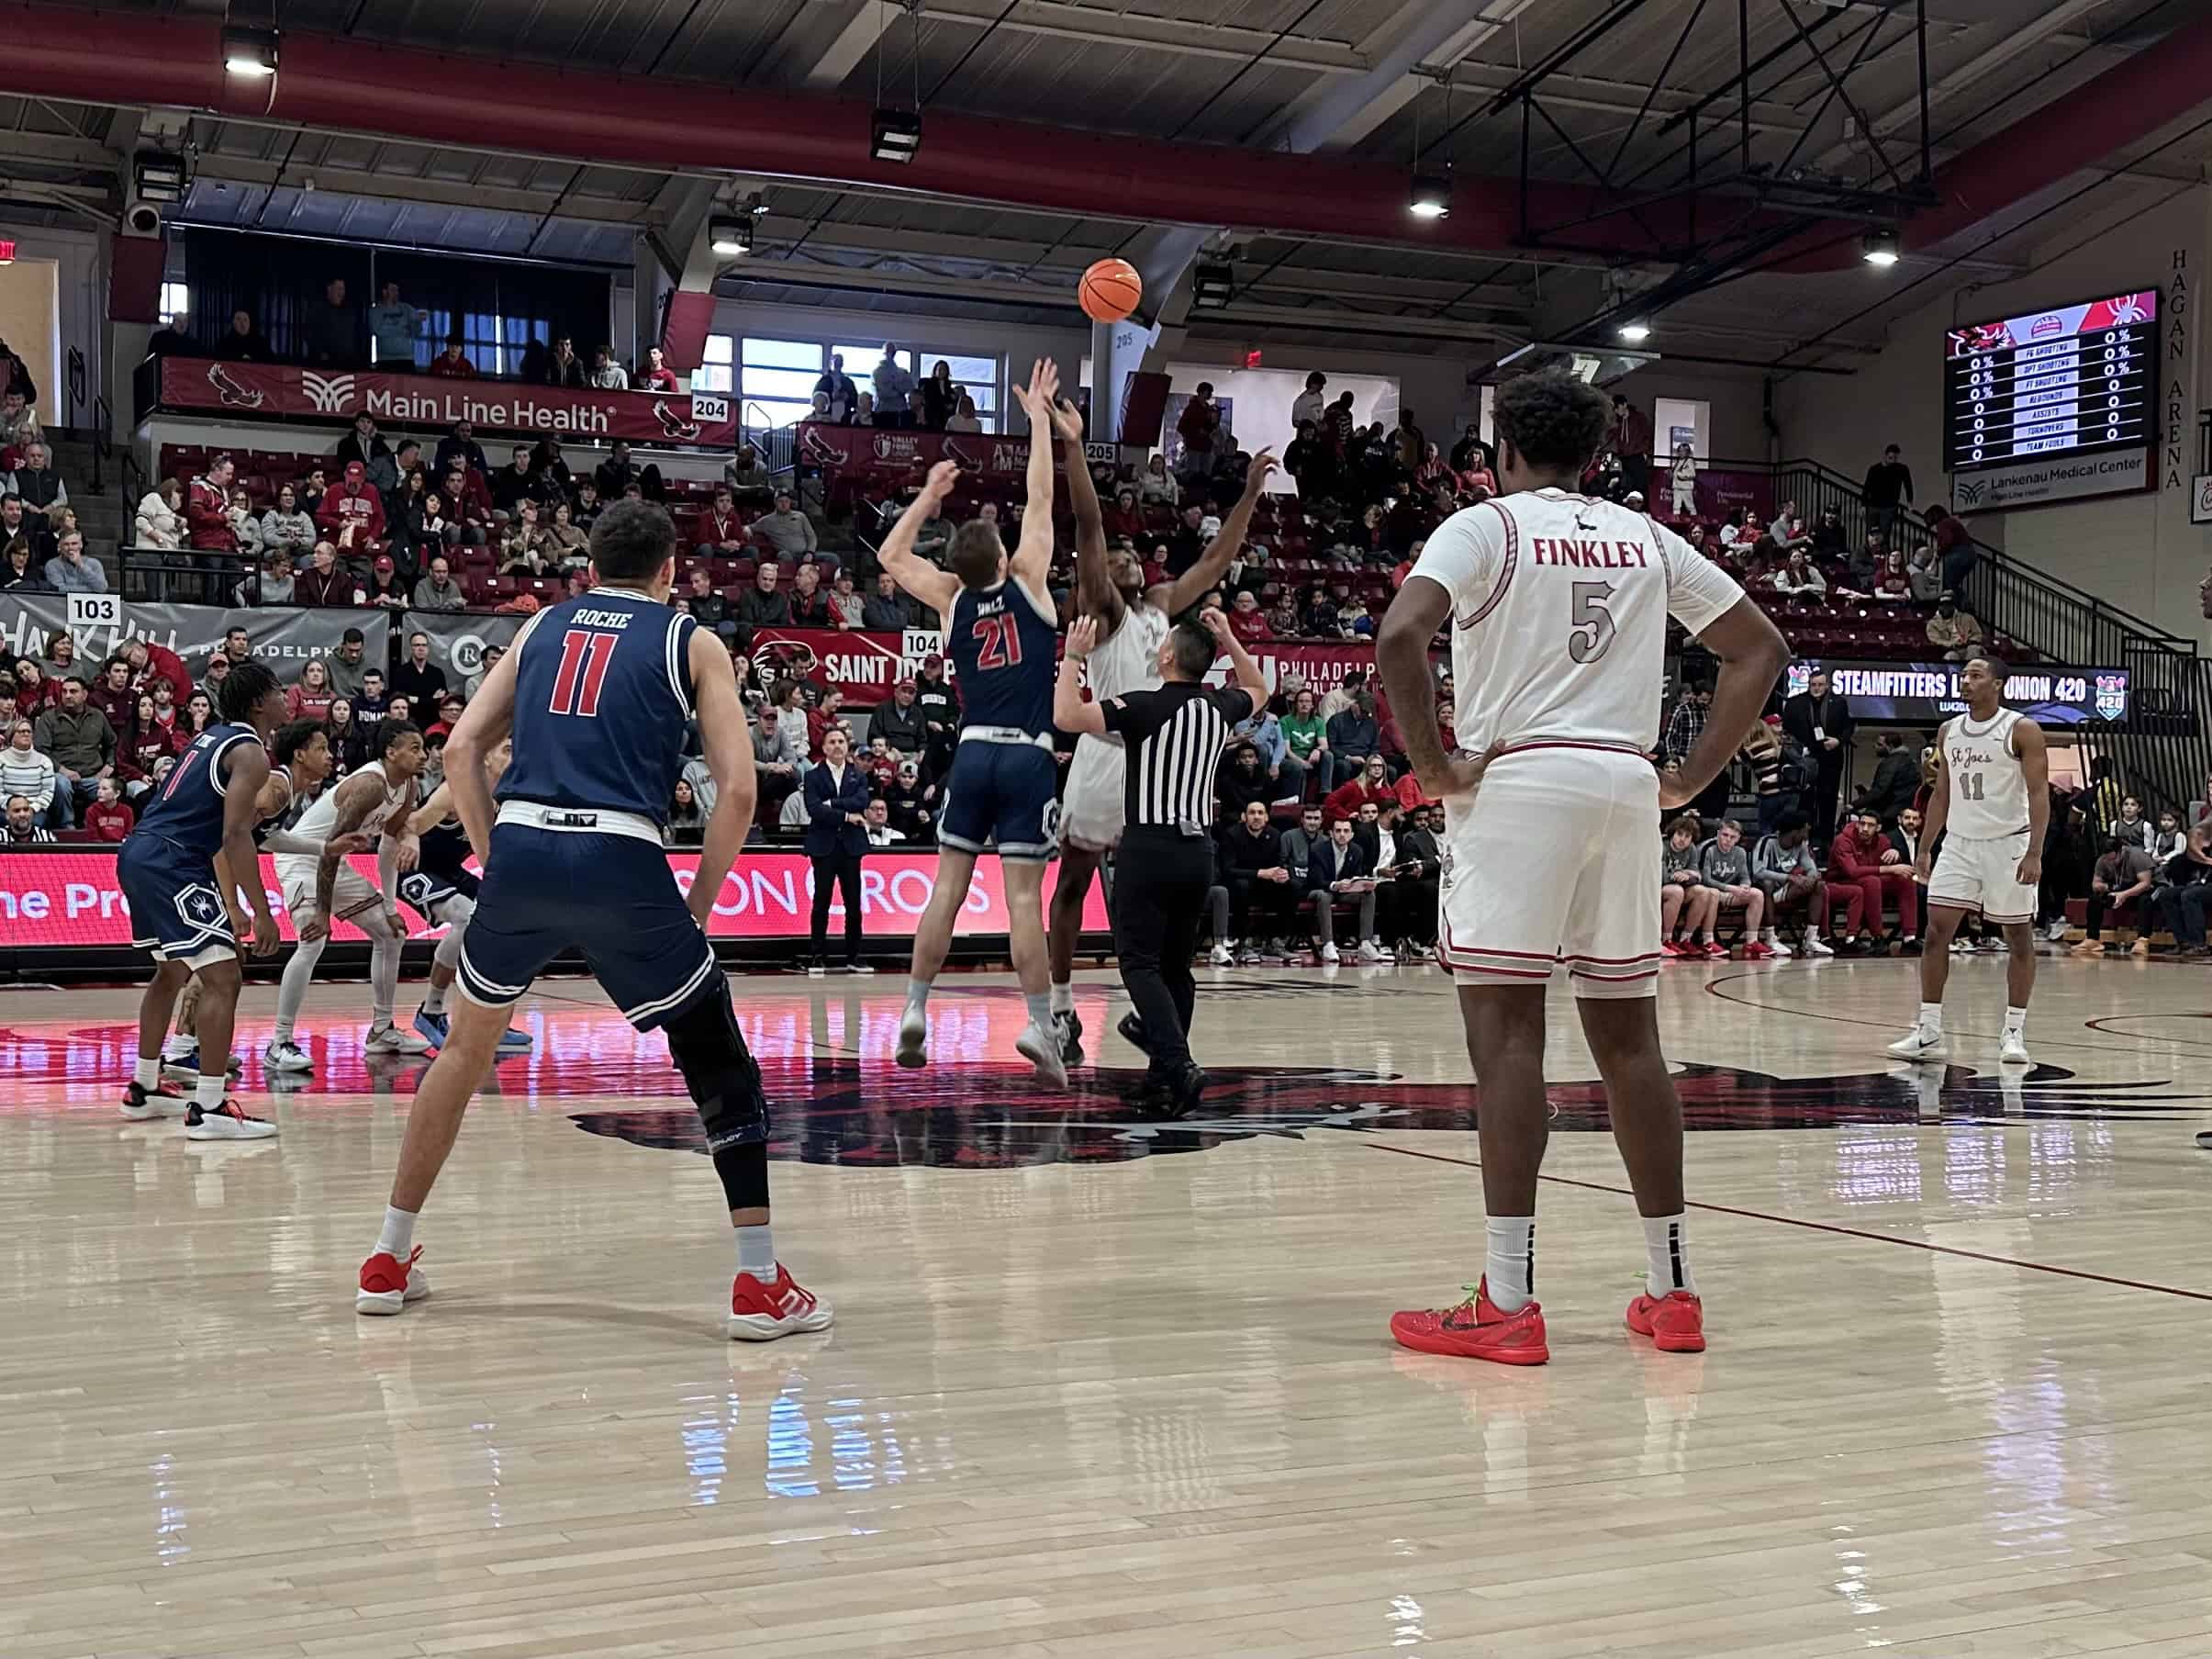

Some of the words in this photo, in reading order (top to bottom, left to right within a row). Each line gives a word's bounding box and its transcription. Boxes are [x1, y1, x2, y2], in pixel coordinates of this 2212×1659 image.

[2169, 249, 2186, 360] HAGAN
[1116, 332, 1133, 349] 205
[2105, 331, 2116, 344] 0
[2105, 347, 2116, 361] 0
[1971, 358, 1981, 369] 0
[2104, 364, 2115, 377] 0
[1971, 373, 1980, 385] 0
[2109, 379, 2119, 392] 0
[1970, 388, 1980, 400] 0
[2108, 395, 2119, 409] 0
[367, 388, 437, 419] Main
[445, 395, 507, 424] Line
[696, 400, 726, 418] 204
[1974, 403, 1984, 415] 0
[1974, 419, 1983, 431] 0
[2108, 411, 2119, 424] 0
[1974, 433, 1983, 445] 0
[2106, 428, 2117, 441] 0
[2165, 379, 2184, 488] ARENA
[1089, 445, 1113, 459] 205
[1972, 449, 1982, 461] 0
[1991, 471, 2048, 489] Lankenau
[2050, 463, 2097, 481] Medical
[2099, 458, 2142, 474] Center
[1533, 538, 1648, 567] FINKLEY
[74, 600, 114, 619] 103
[571, 609, 633, 629] ROCHE
[1569, 580, 1616, 664] 5
[908, 636, 938, 652] 104
[972, 611, 1022, 671] 21
[199, 645, 334, 658] PHADELPH
[549, 630, 619, 717] 11
[825, 654, 889, 683] SAINT
[1279, 661, 1376, 681] PHILADEP
[1832, 669, 1947, 698] STEAMFITTERS
[2054, 677, 2086, 701] 420
[2098, 696, 2125, 709] 420
[162, 749, 199, 801] 1
[1959, 772, 1984, 801] 11
